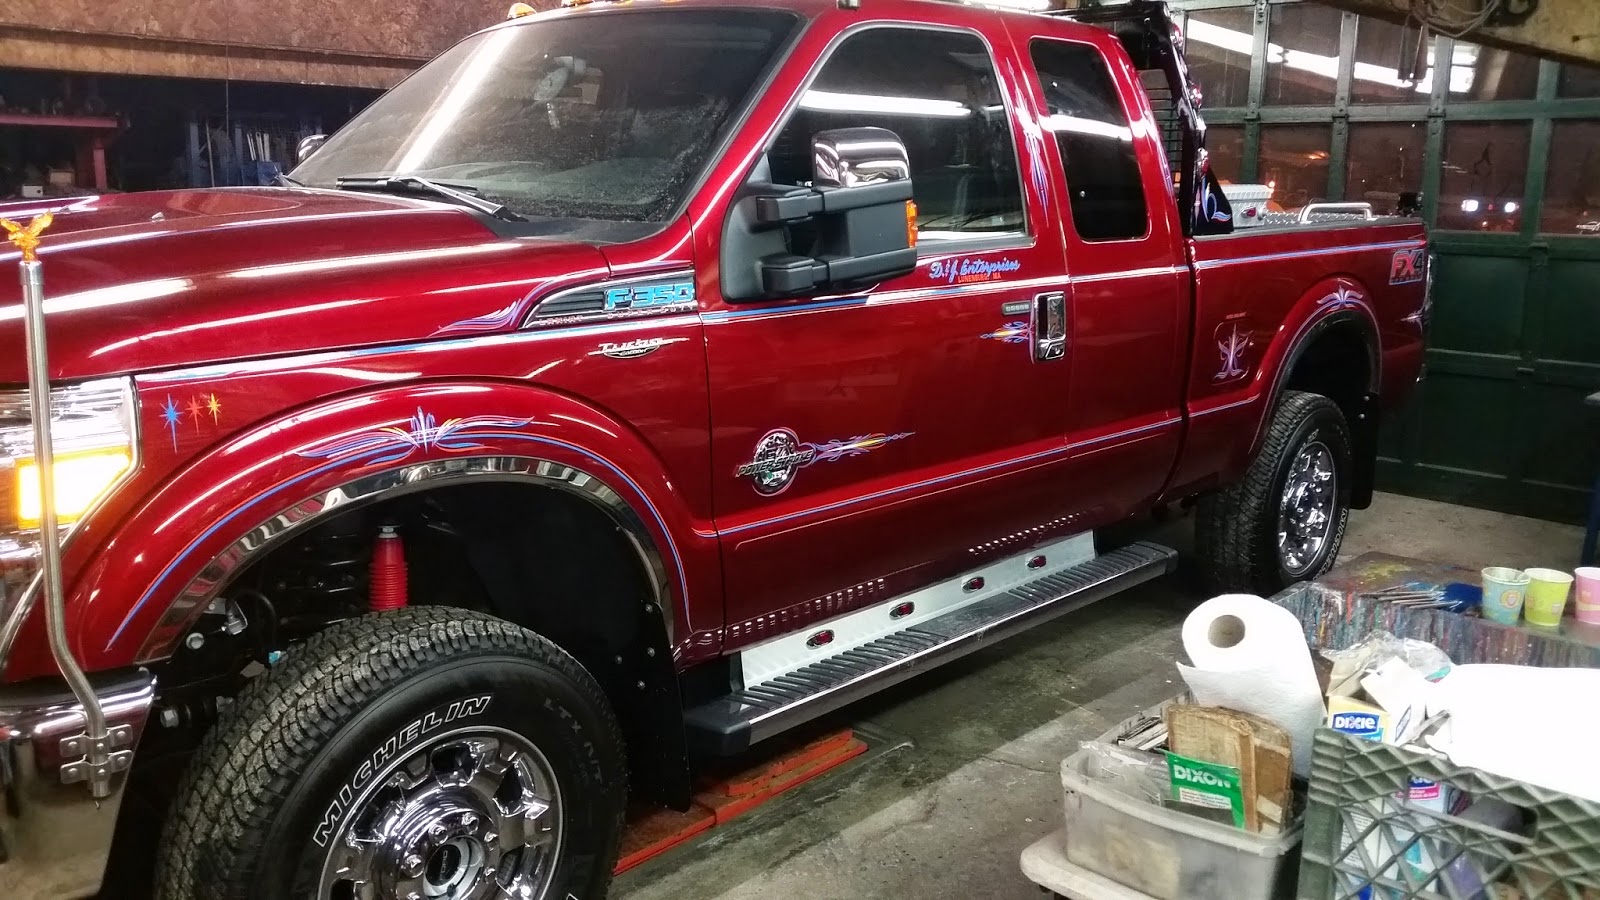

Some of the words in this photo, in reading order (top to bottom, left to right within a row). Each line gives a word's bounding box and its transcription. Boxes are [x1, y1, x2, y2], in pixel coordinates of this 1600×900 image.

[960, 257, 1020, 277] Enterprises
[1391, 249, 1424, 278] FX4
[607, 307, 653, 319] SUPER
[660, 303, 694, 314] DUTY
[313, 695, 491, 848] MICHELIN
[1174, 764, 1231, 788] DIXON
